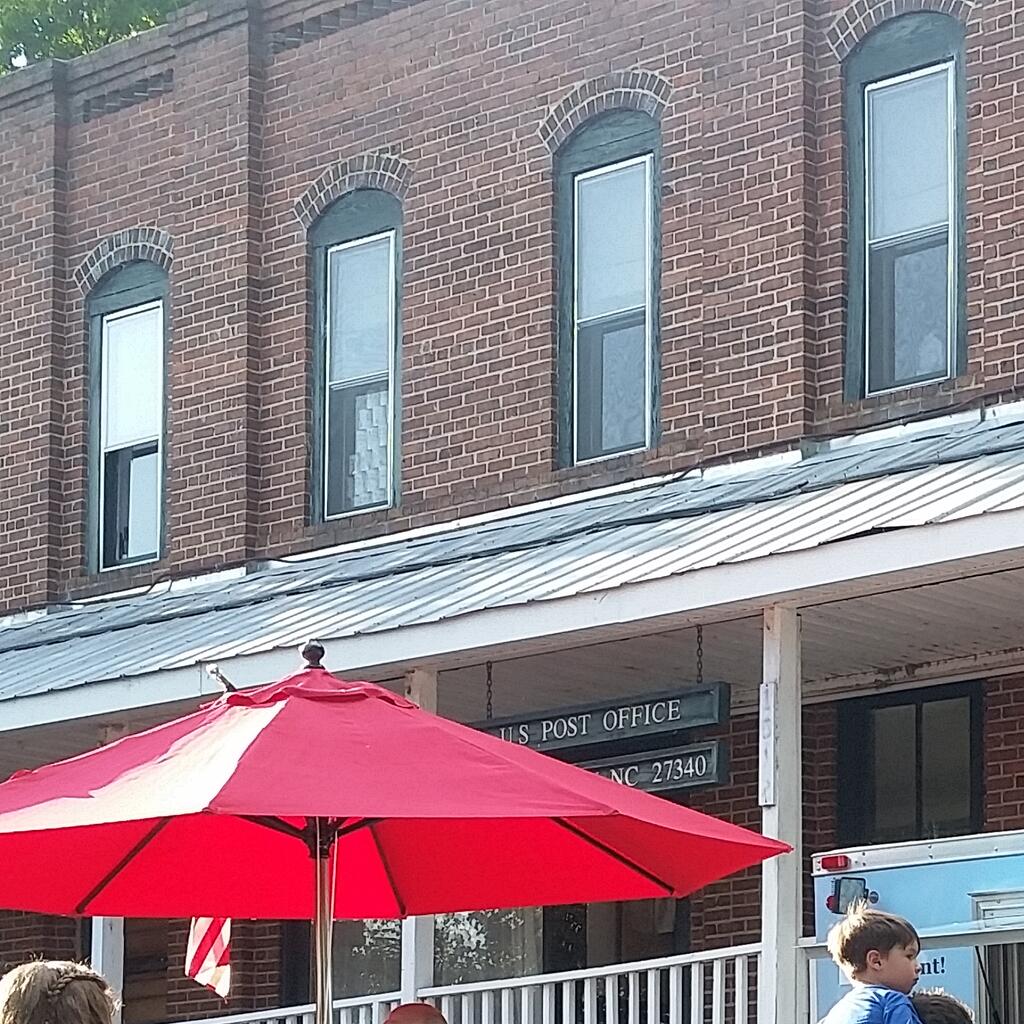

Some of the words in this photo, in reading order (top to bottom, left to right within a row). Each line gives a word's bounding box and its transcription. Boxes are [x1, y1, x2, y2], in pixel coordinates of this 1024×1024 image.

[541, 714, 591, 741] POST
[603, 699, 681, 731] OFFICE
[610, 766, 638, 787] NC
[652, 755, 706, 783] 27340
